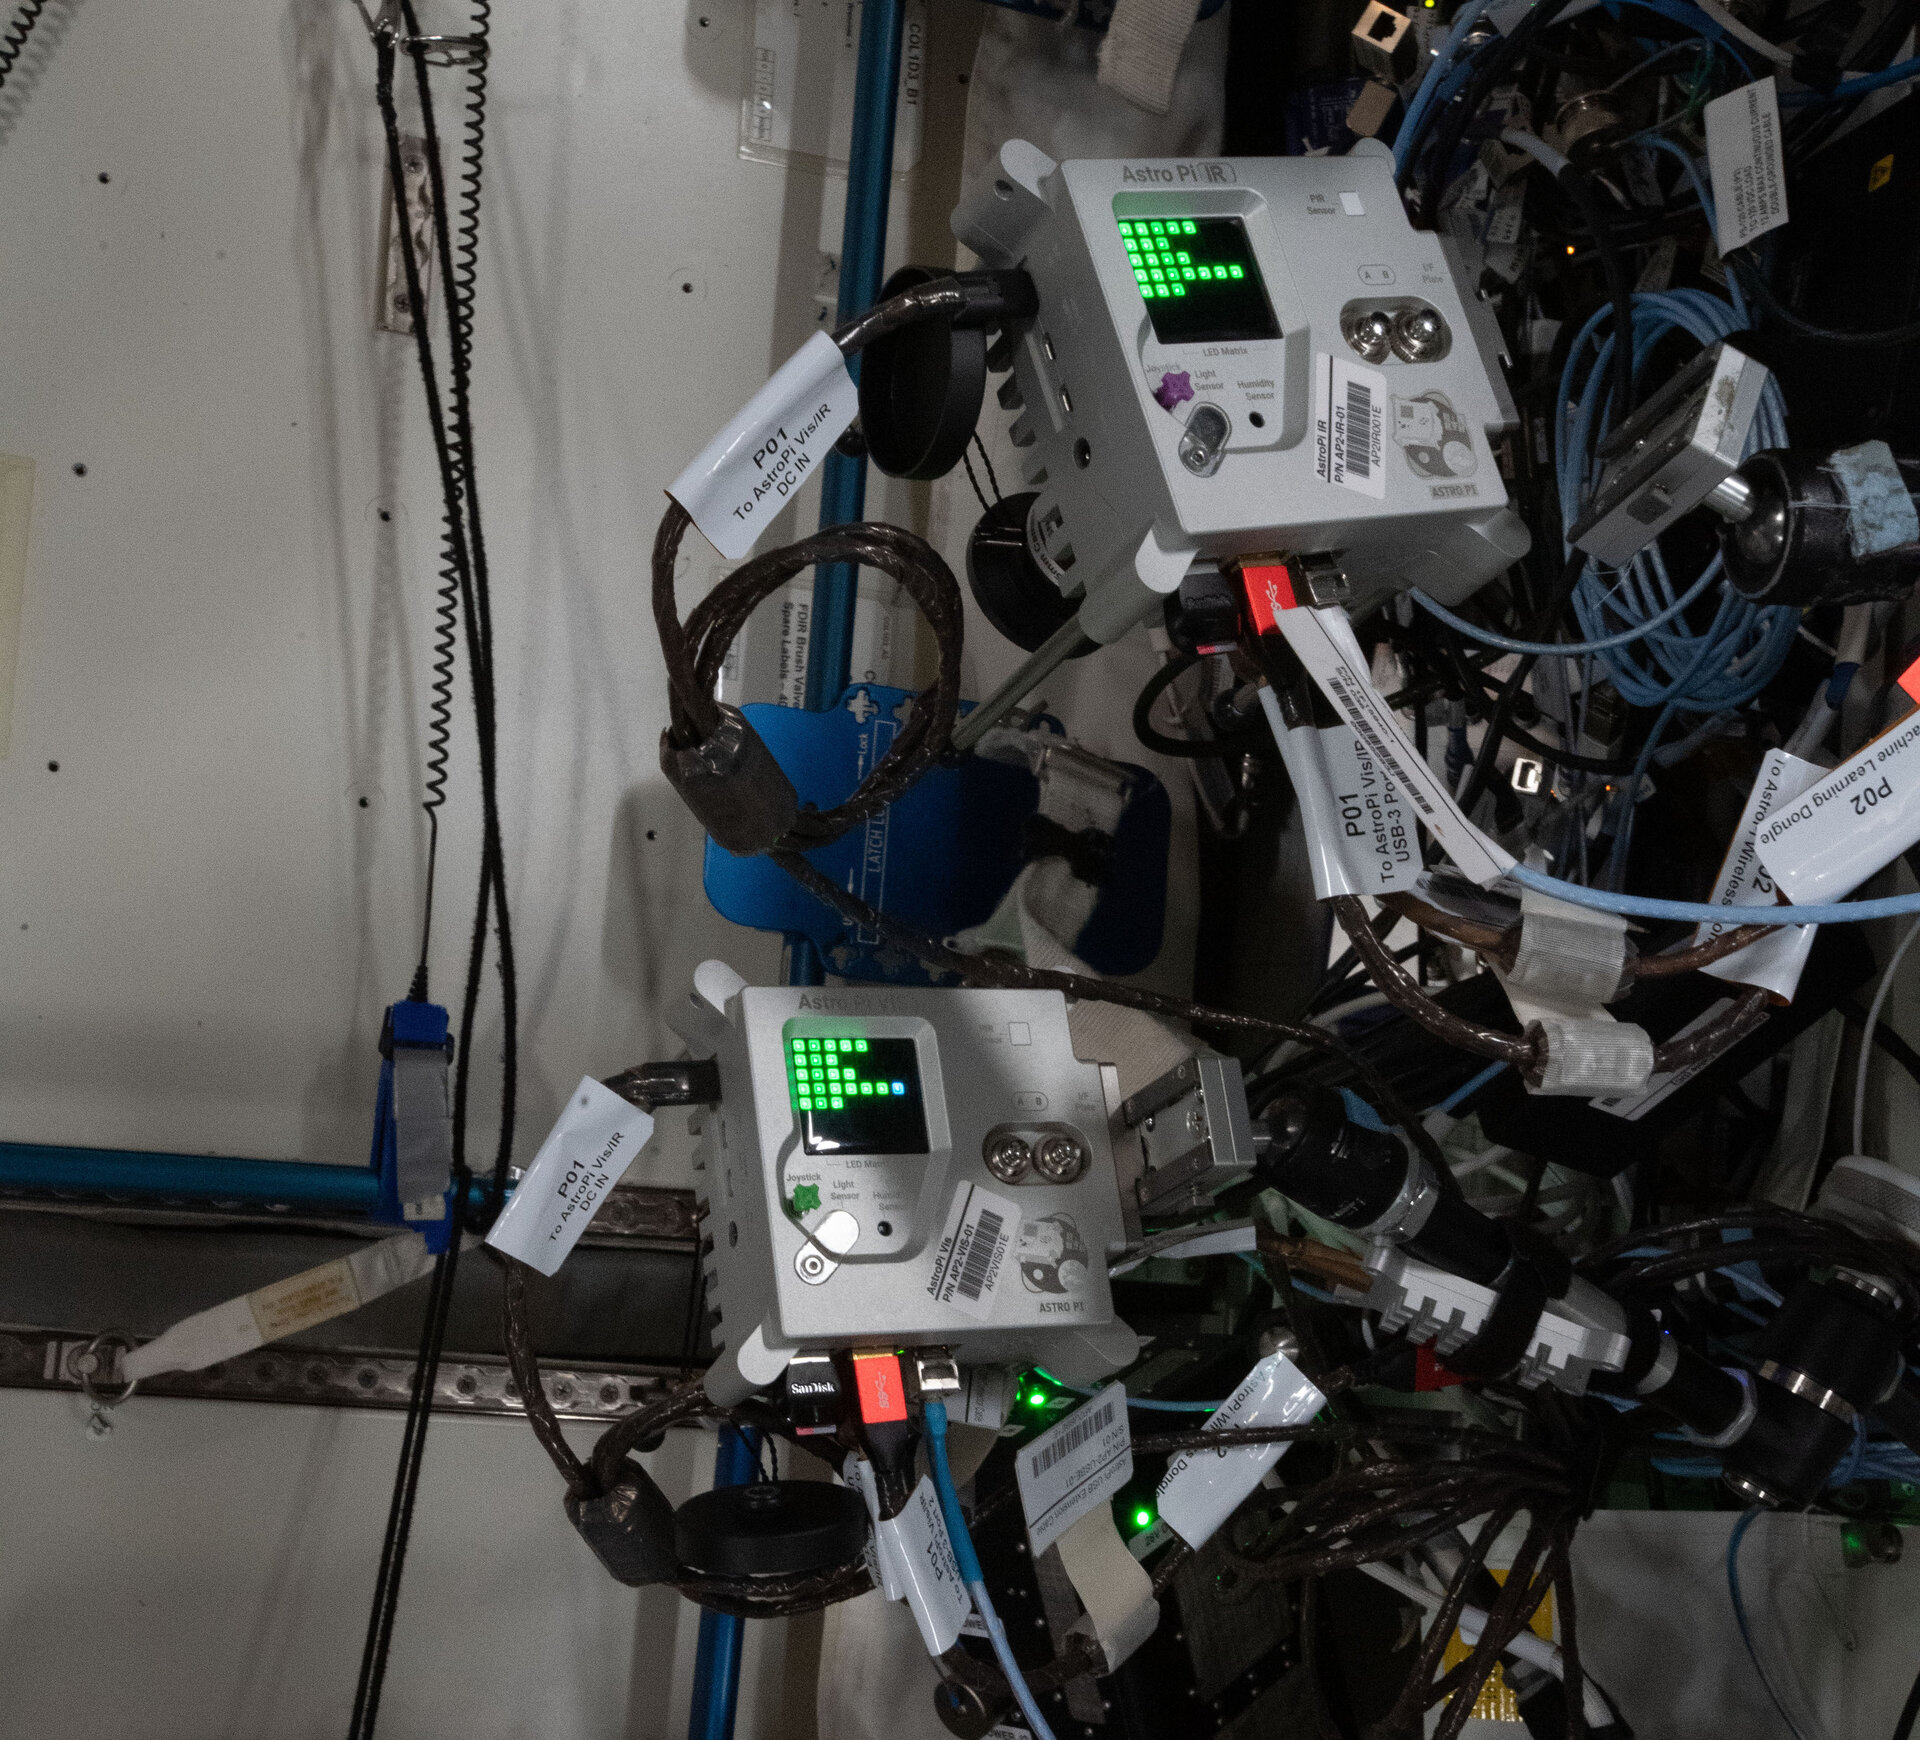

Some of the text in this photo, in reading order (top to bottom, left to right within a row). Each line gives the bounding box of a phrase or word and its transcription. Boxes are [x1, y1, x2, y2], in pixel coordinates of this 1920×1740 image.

[1748, 88, 1759, 124] CURRENT
[1762, 111, 1772, 138] CABLE
[1752, 125, 1764, 174] CONTINUOUS
[1122, 164, 1226, 183] Astro Pi IR
[1306, 206, 1336, 215] Sensor
[1203, 347, 1248, 356] LED Matrix
[1194, 370, 1217, 379] Light
[1195, 383, 1224, 391] Sensor
[1237, 380, 1275, 389] Humidity
[1245, 393, 1275, 401] Sensor
[753, 427, 788, 470] P01
[1316, 420, 1327, 477] AstroPi IR
[1334, 405, 1345, 484] P/N AP2-IR-01
[1371, 405, 1382, 467] AP2IR001E
[733, 403, 831, 520] To AstroPi Vis/IR
[776, 453, 811, 497] DC IN
[1432, 484, 1478, 498] ASTRO PI
[782, 601, 794, 637] Spare
[797, 603, 809, 633] FDIR
[779, 639, 791, 679] Labels
[795, 636, 807, 673] Brush
[857, 733, 869, 755] Lock
[1760, 725, 1920, 845] achine Learning Dongle
[1850, 776, 1893, 816] P02
[1339, 793, 1366, 837] P01
[1365, 792, 1390, 855] AstroPi
[868, 830, 884, 873] LATCH
[1388, 809, 1410, 862] USB-3
[1380, 861, 1395, 883] To
[1722, 841, 1755, 906] Wireless
[799, 993, 848, 1010] Astro
[557, 1160, 585, 1199] P01
[786, 1173, 821, 1183] Joystick
[846, 1160, 862, 1169] LED
[550, 1131, 625, 1241] To AstroPi Vis/IR
[580, 1173, 609, 1212] DC IN
[830, 1192, 860, 1200] Sensor
[833, 1180, 855, 1190] Light
[927, 1237, 952, 1296] AstroPi Vis
[942, 1223, 974, 1303] P/N AP2-VIS-01
[985, 1232, 1010, 1292] AP2VIS01E
[1039, 1301, 1085, 1313] ASTRO PI
[791, 1381, 835, 1394] SanDisk
[1226, 1370, 1267, 1415] AstroPi
[1055, 1487, 1087, 1520] Extension
[1087, 1476, 1104, 1494] USB
[926, 1541, 943, 1581] P01
